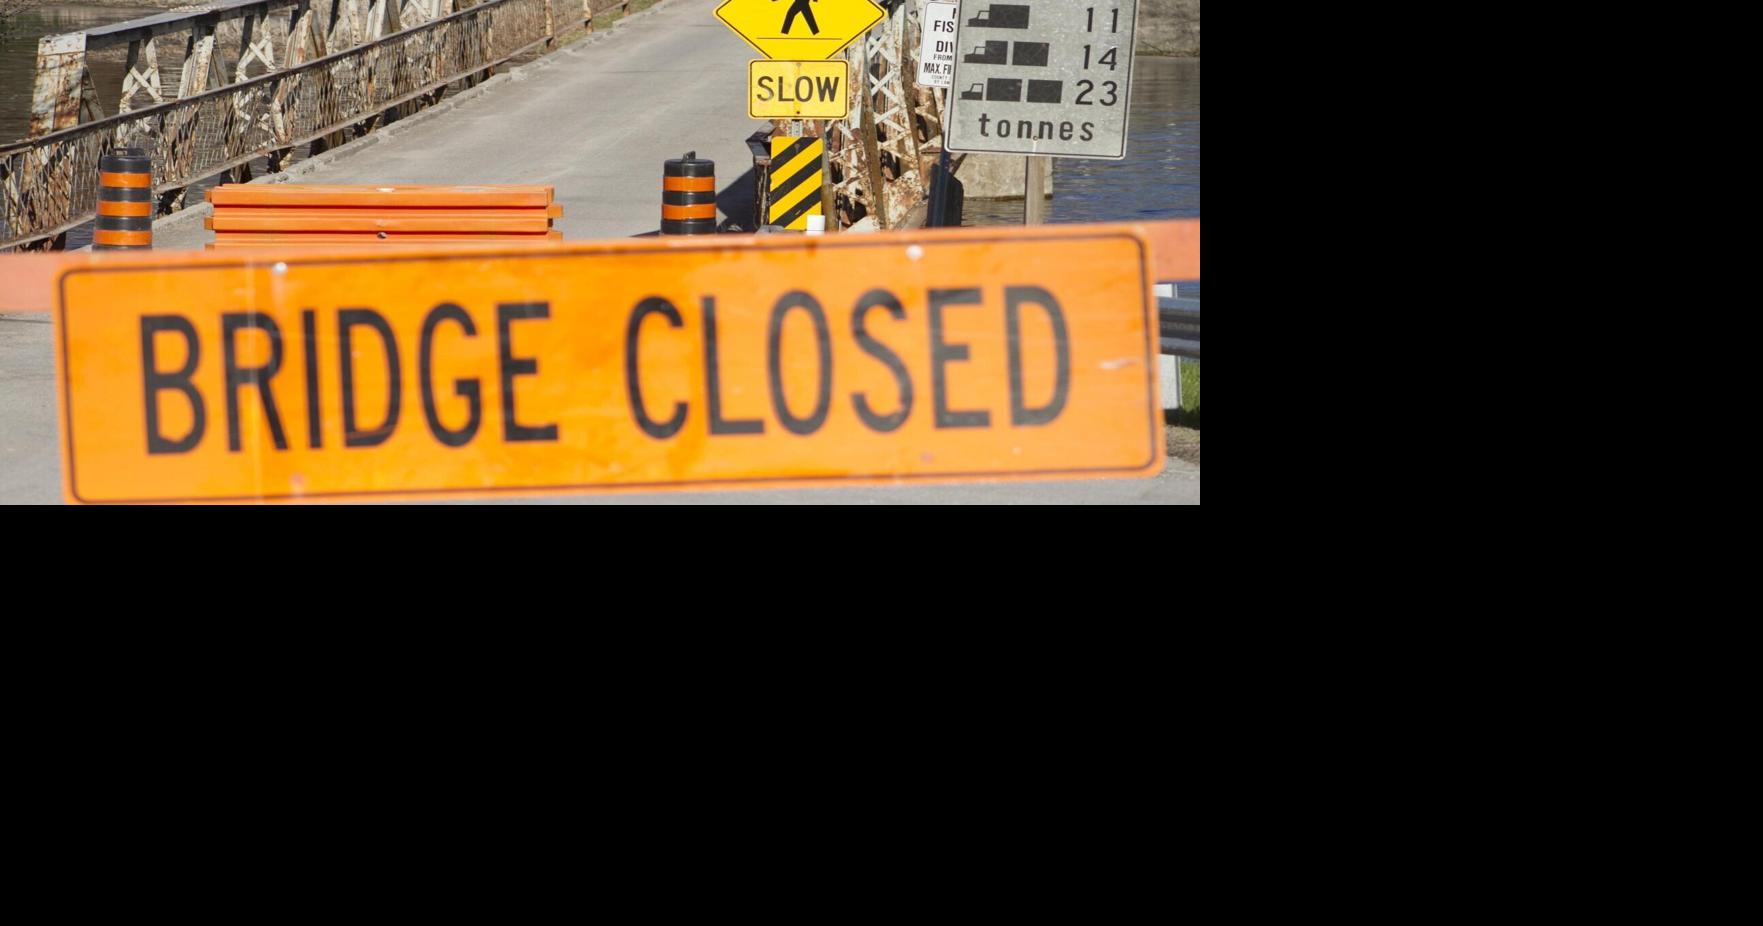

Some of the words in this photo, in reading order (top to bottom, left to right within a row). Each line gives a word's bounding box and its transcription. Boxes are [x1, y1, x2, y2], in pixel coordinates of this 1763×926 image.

[1086, 7, 1119, 33] 11
[924, 63, 941, 74] MAX.
[1083, 44, 1118, 71] 14
[757, 75, 839, 102] SLOW
[1075, 79, 1118, 106] 23
[979, 113, 1095, 141] tonnes
[139, 301, 559, 456] BRIDGE
[625, 285, 1071, 438] CLOSED
